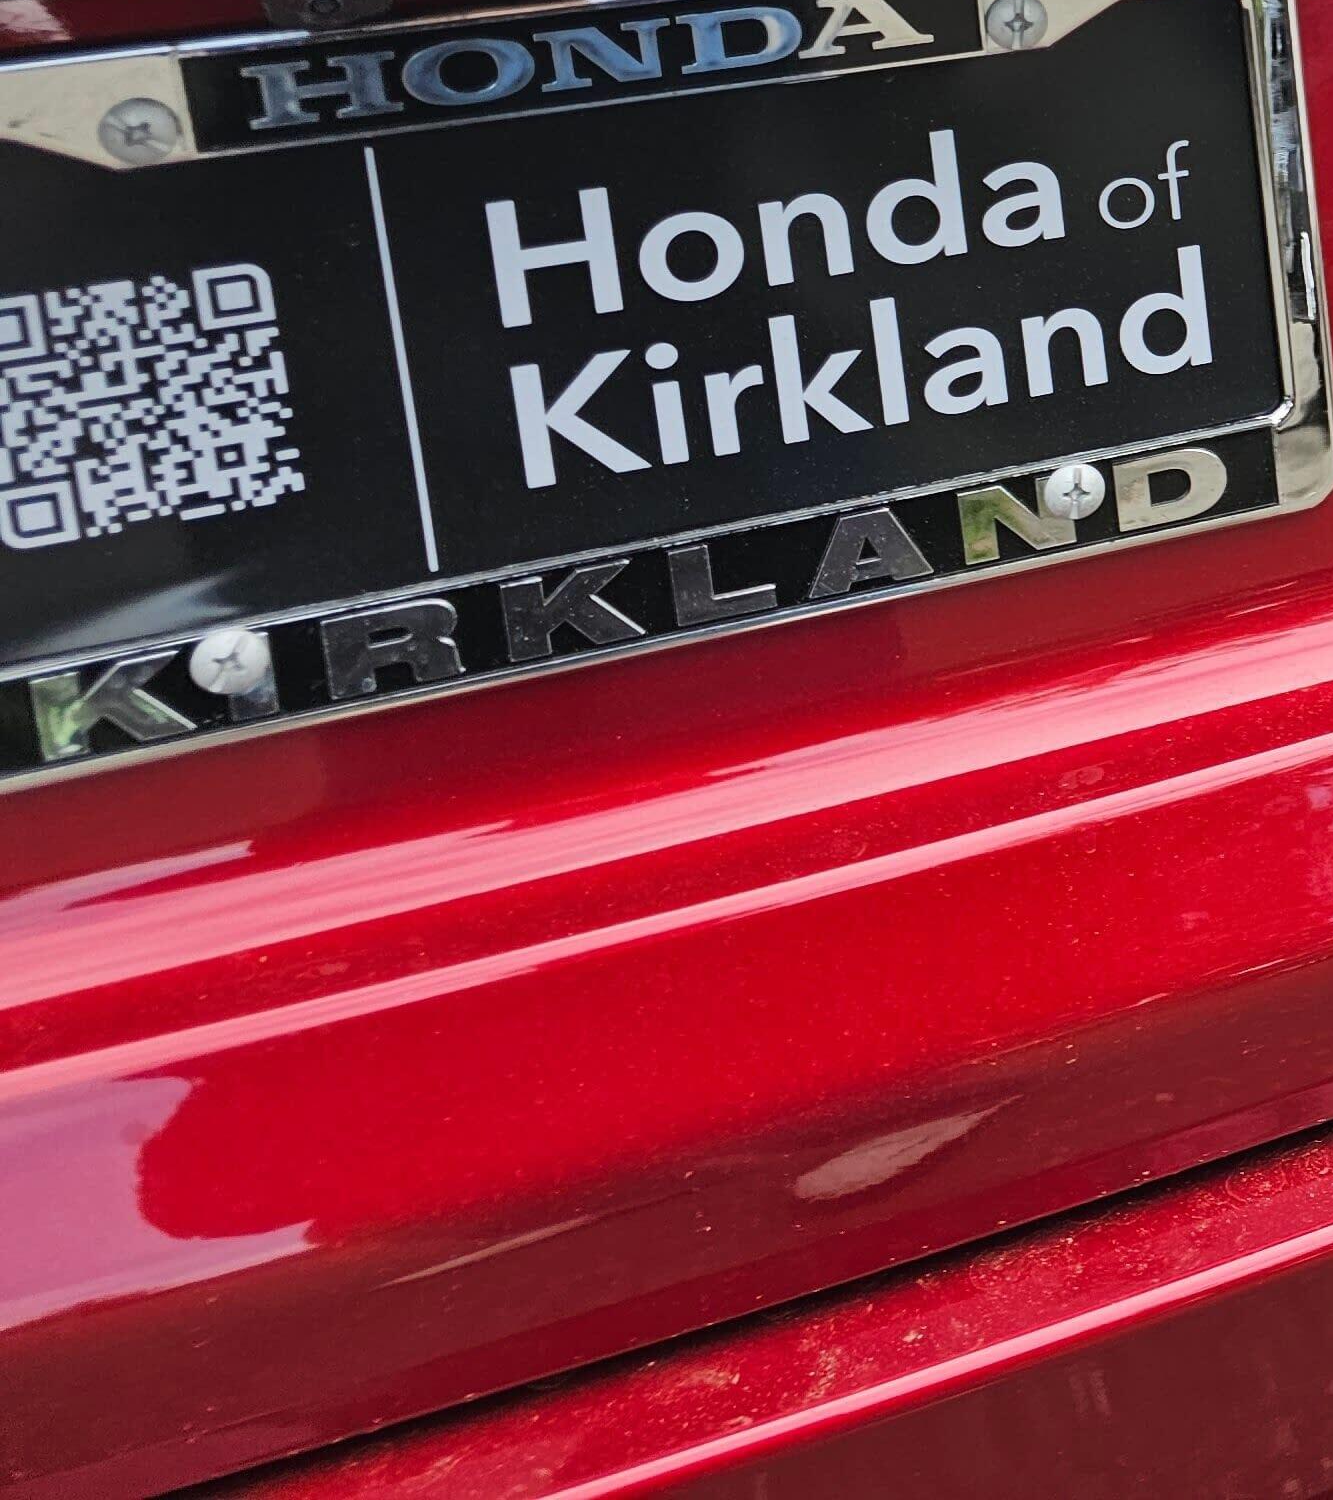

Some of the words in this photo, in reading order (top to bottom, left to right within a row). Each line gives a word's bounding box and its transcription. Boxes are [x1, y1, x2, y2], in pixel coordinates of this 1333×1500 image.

[484, 129, 1066, 328] Honda
[1099, 140, 1190, 230] of
[510, 245, 1214, 489] Kirkland
